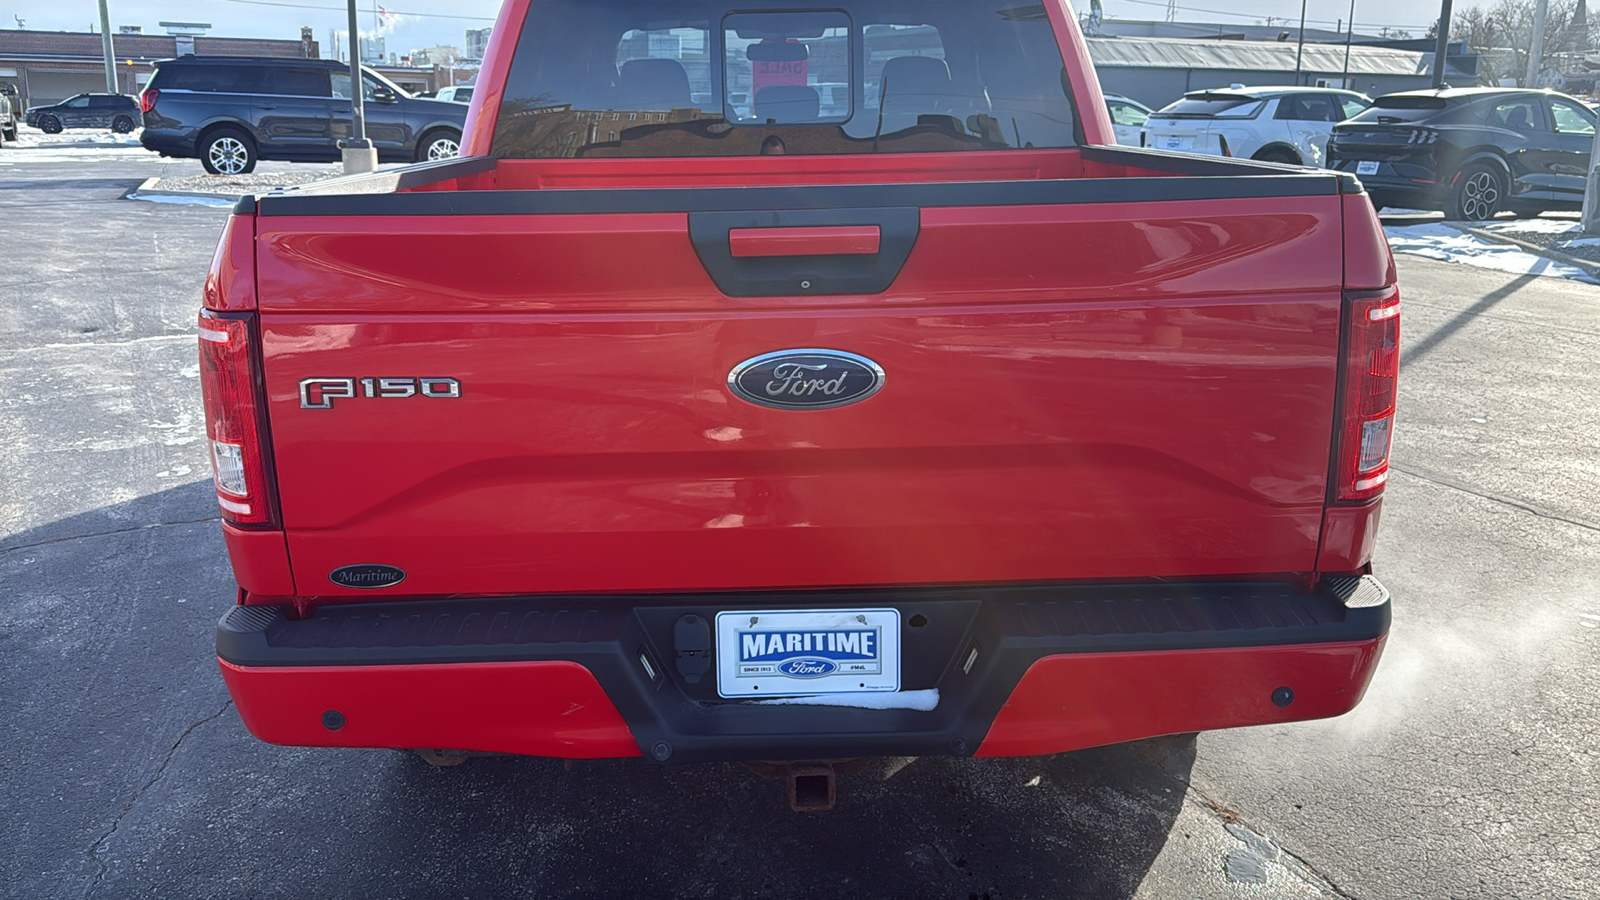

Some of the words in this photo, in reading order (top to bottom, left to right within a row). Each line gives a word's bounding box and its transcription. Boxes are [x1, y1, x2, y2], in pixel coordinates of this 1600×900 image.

[765, 362, 848, 396] Ford
[338, 569, 399, 582] Maritime
[742, 631, 875, 660] MARITIME
[788, 661, 826, 674] Ford
